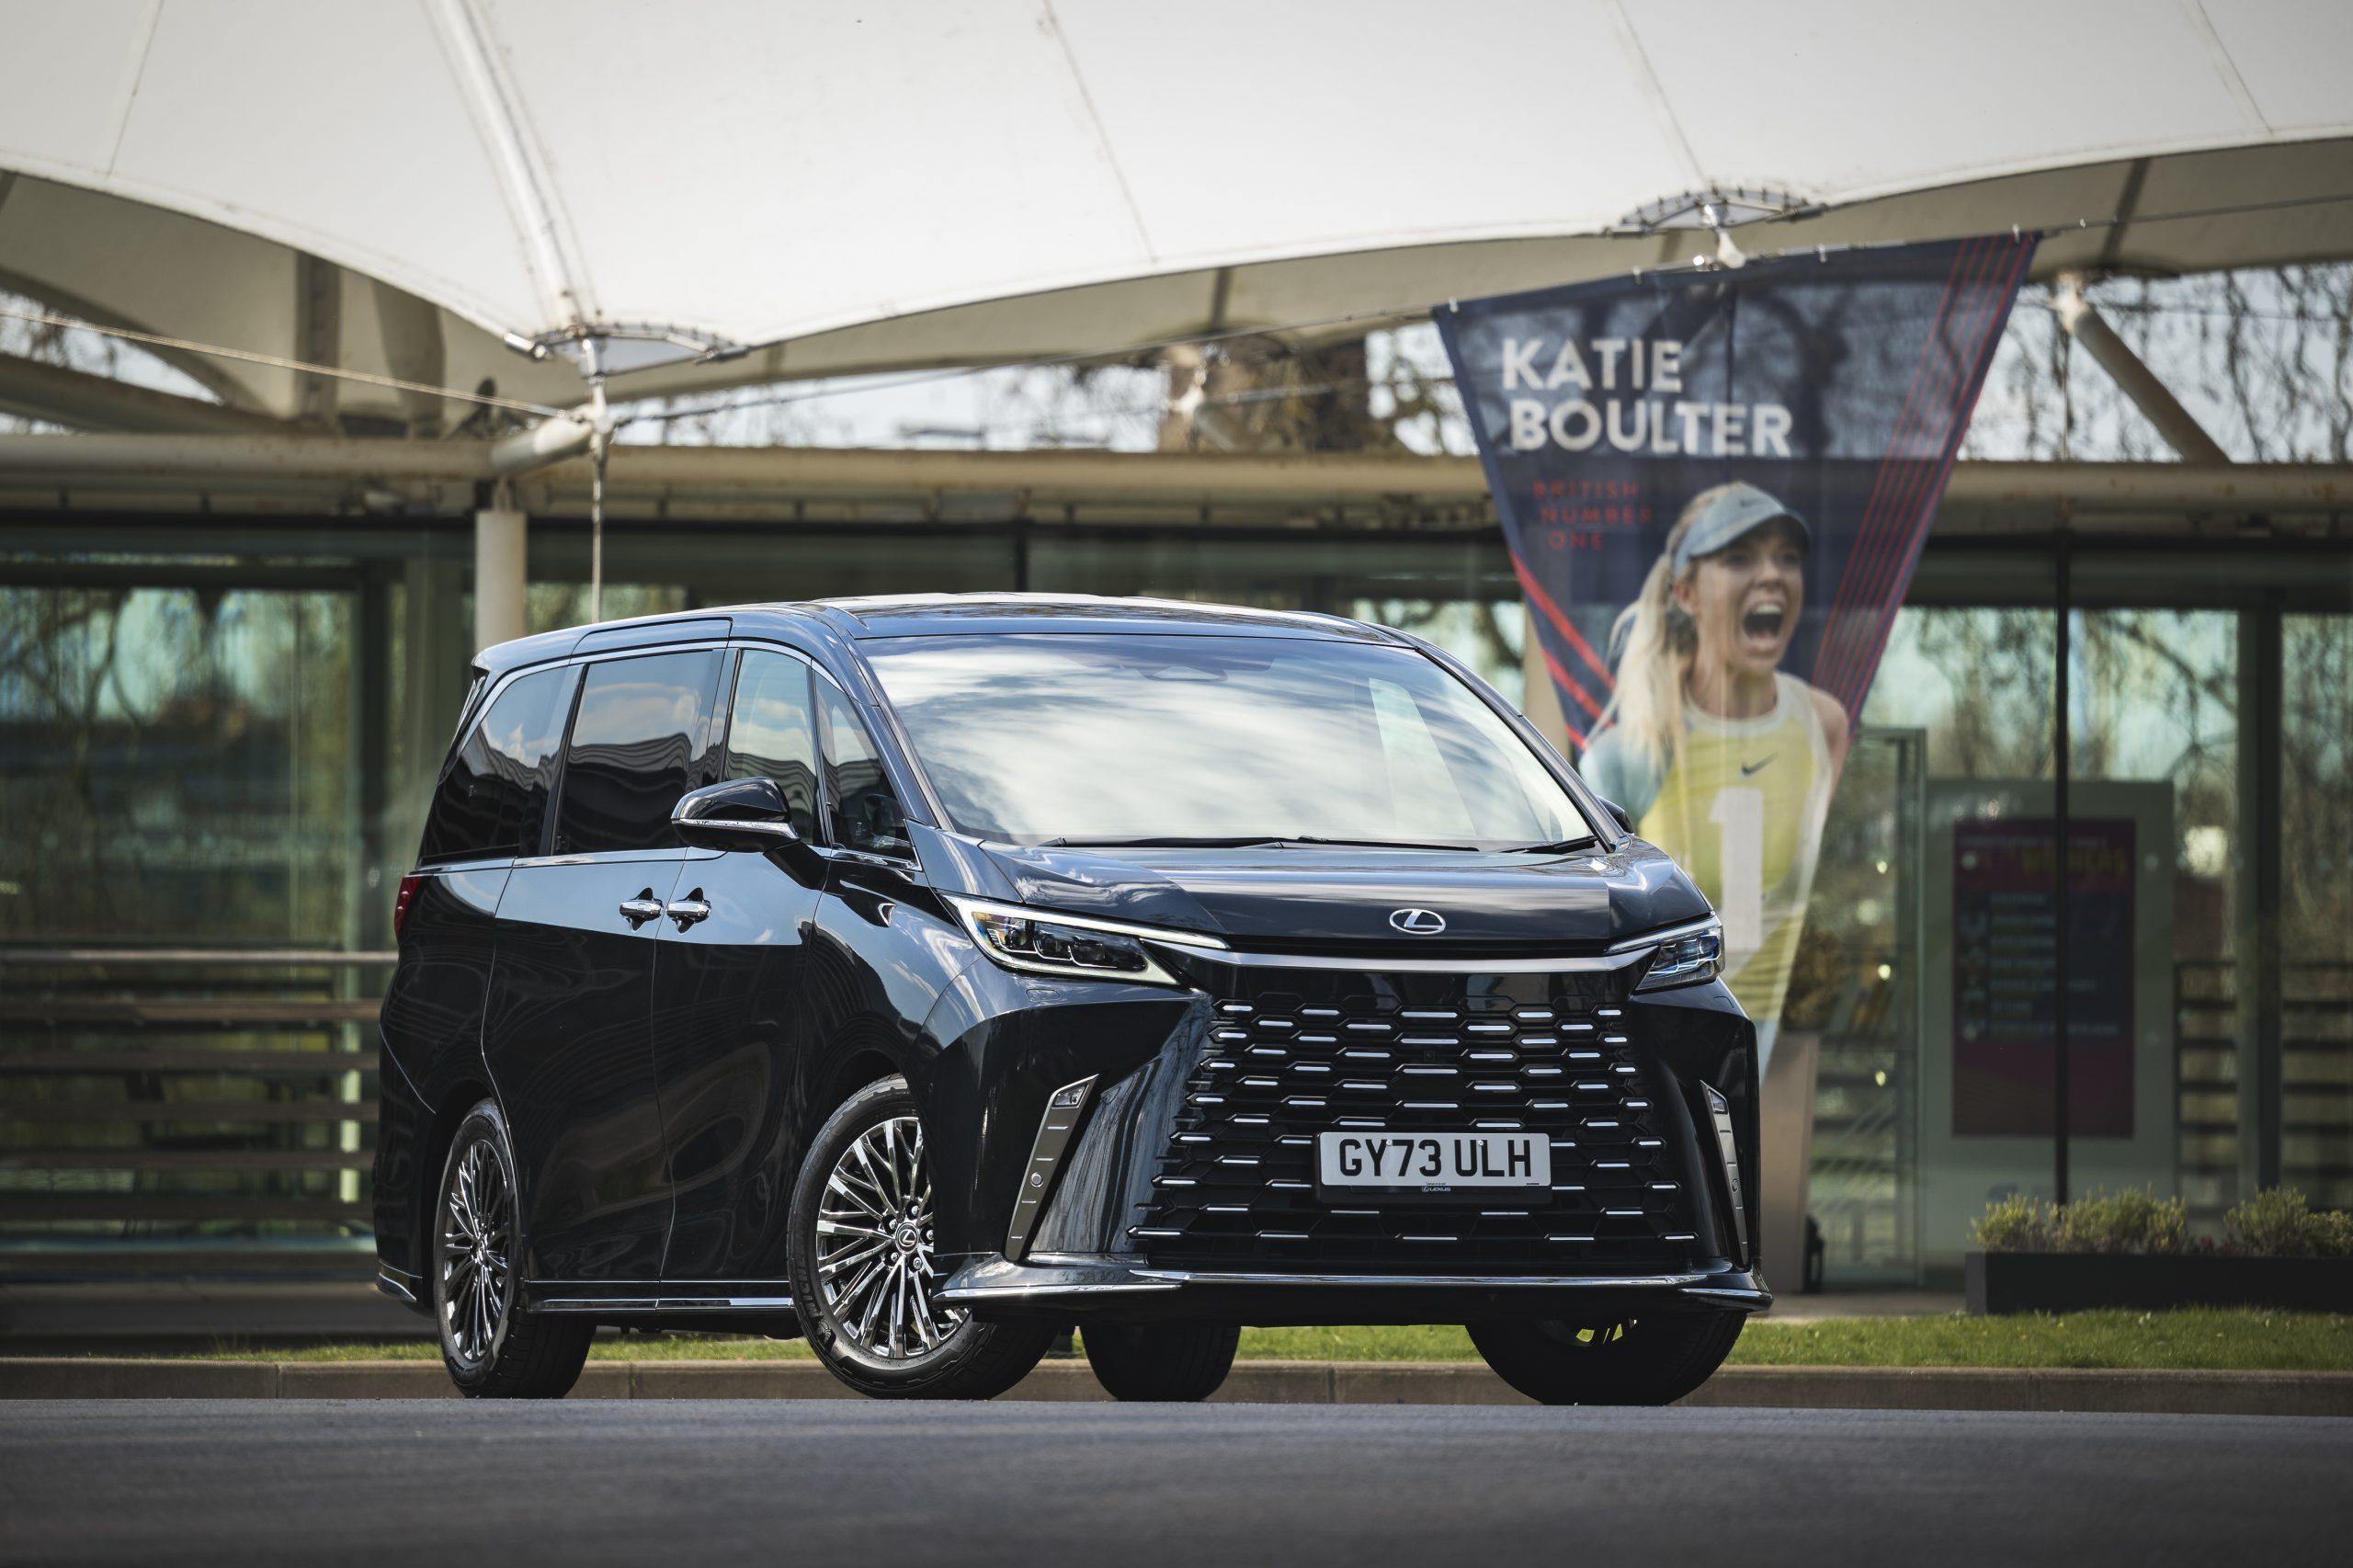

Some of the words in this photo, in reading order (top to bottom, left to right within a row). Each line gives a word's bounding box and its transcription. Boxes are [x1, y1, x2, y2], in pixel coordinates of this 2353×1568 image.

[1502, 337, 1683, 393] KATIE
[1510, 399, 1793, 458] BOULTER
[1533, 479, 1640, 498] BRITISH
[1540, 505, 1653, 526] NUMBER
[1547, 530, 1603, 551] ONE
[1339, 1139, 1441, 1177] GY73
[1454, 1139, 1531, 1177] ULH
